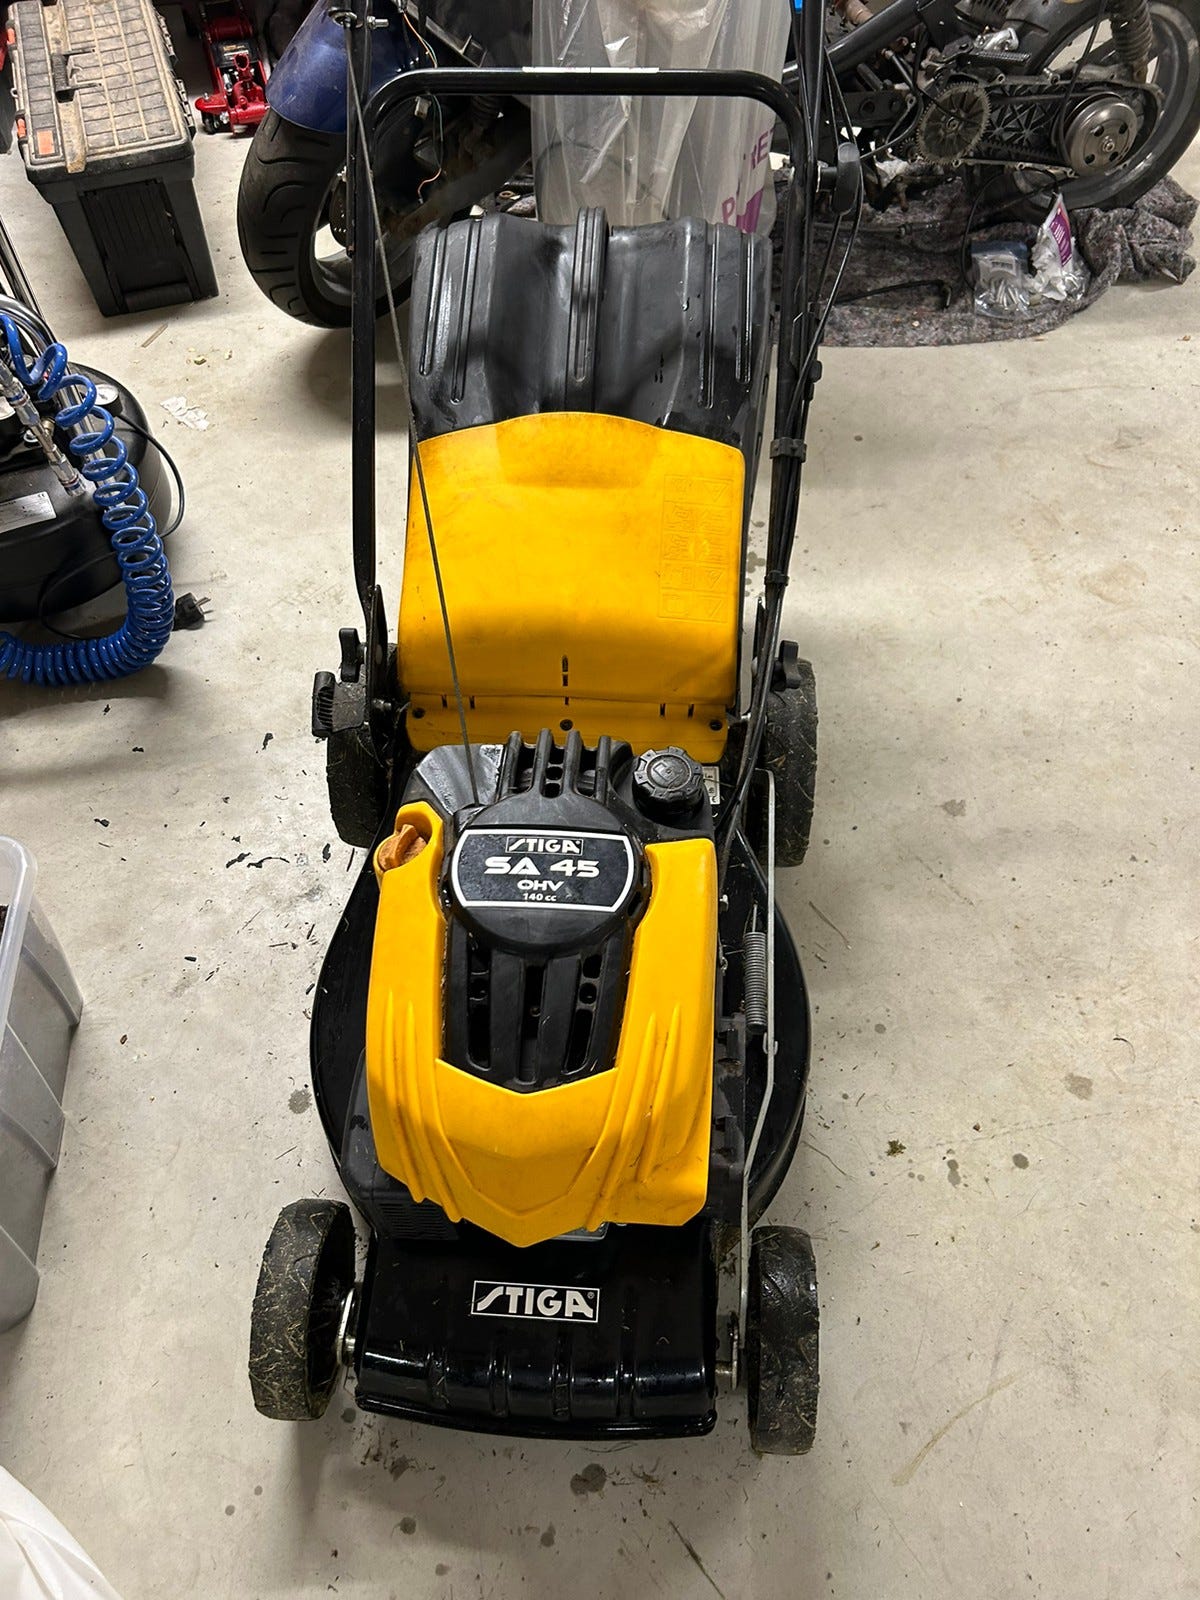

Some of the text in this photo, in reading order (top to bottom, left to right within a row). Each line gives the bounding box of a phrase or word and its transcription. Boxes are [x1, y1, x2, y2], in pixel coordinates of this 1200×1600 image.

[484, 856, 600, 878] SA 45
[517, 879, 564, 892] OHV
[522, 892, 557, 902] 140 cc
